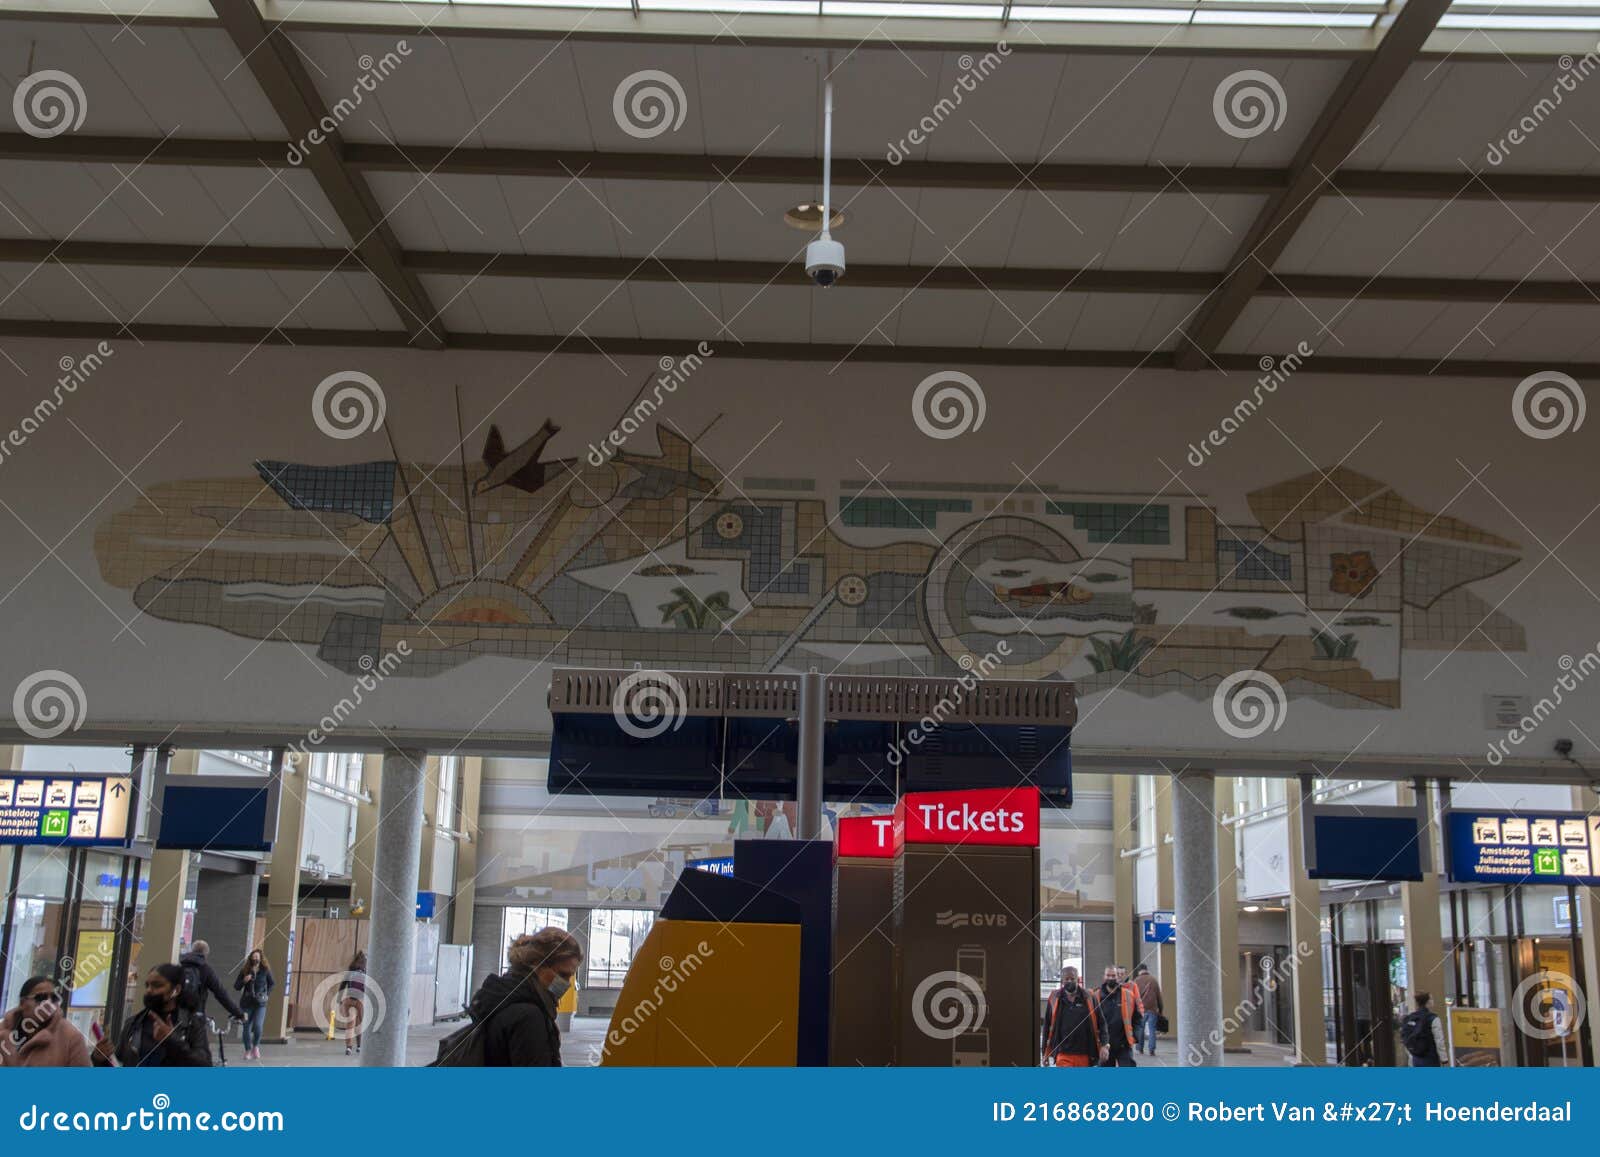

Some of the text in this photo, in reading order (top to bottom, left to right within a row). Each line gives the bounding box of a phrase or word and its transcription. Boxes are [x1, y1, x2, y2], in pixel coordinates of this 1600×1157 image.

[918, 803, 1025, 832] Tickets
[1480, 847, 1530, 857] Amsteldorp
[971, 913, 1008, 926] GVB
